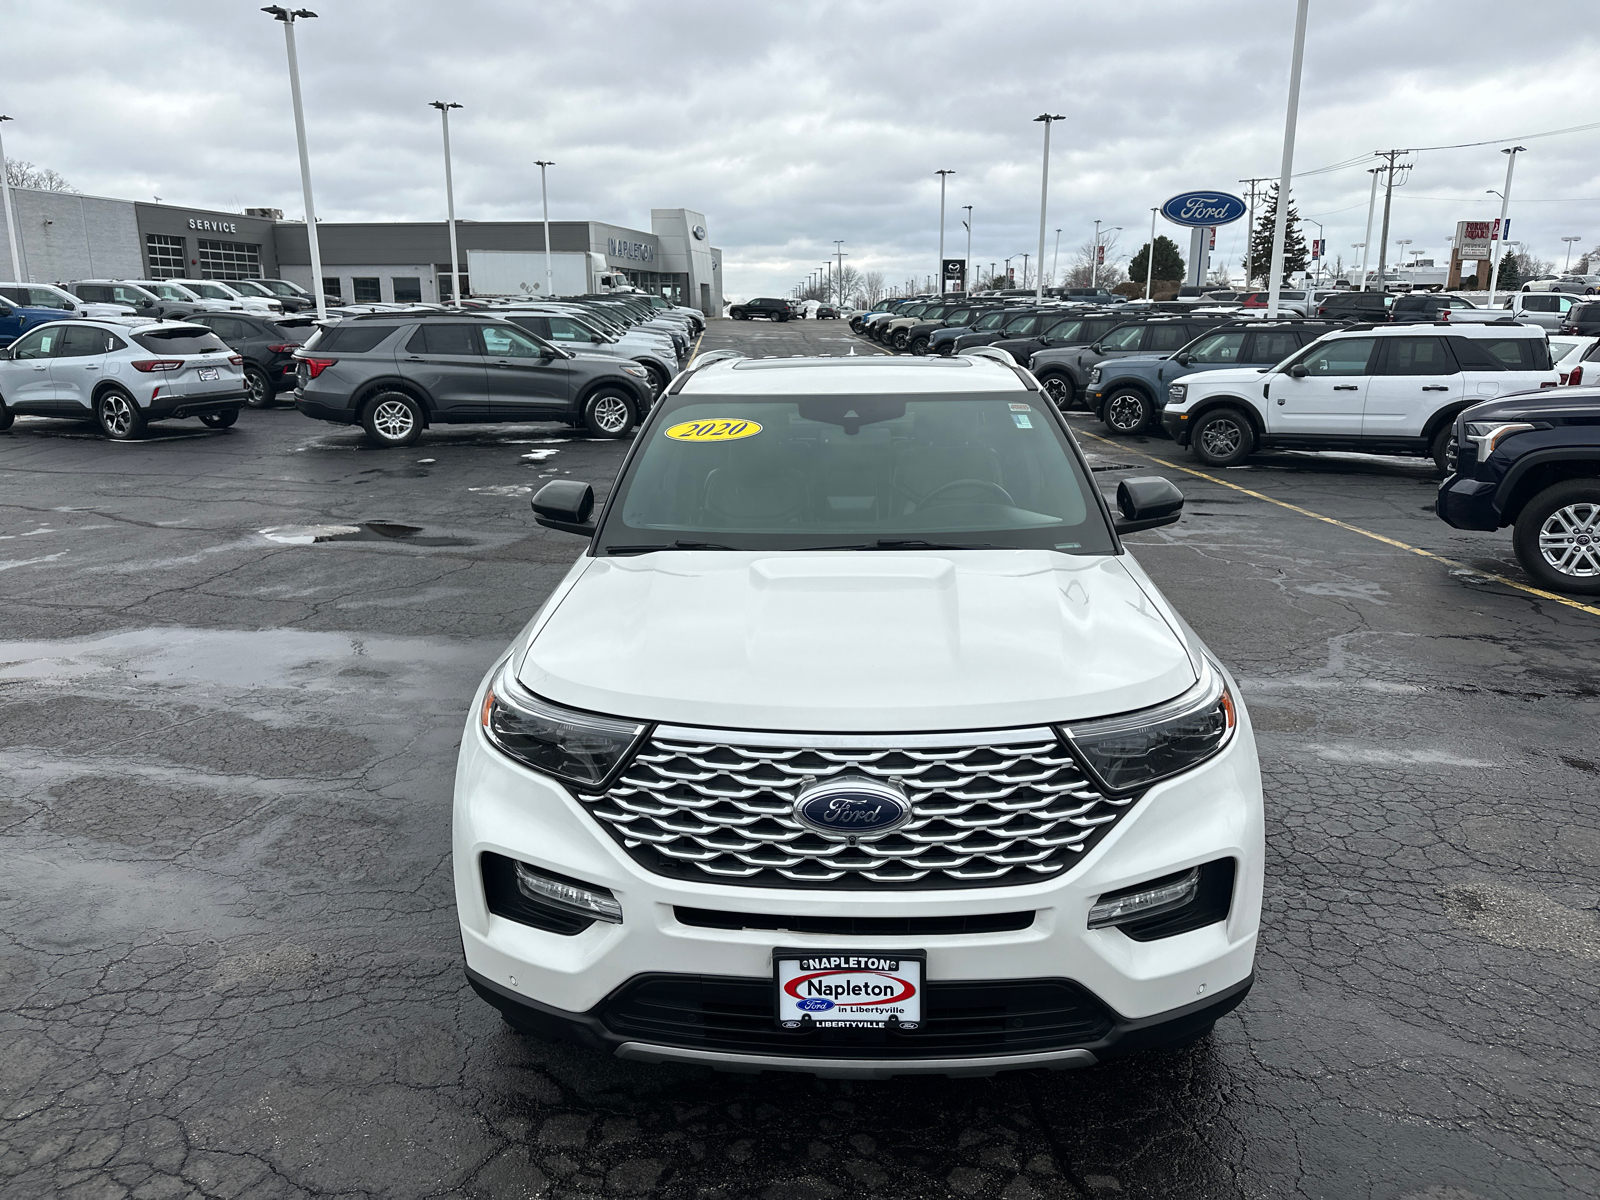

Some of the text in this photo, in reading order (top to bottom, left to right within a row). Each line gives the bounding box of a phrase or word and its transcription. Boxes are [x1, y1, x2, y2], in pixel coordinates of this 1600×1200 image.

[1180, 197, 1231, 219] Ford
[189, 218, 236, 233] SERVICE
[1466, 222, 1490, 231] FORUM
[1464, 230, 1489, 240] SQUARE
[608, 237, 654, 262] NAPLETON
[678, 422, 748, 437] 2020
[823, 798, 882, 823] Ford
[808, 957, 890, 971] NAPLETON
[807, 980, 894, 1000] Napleton
[804, 1000, 829, 1010] Ford
[838, 1006, 905, 1015] in Libertyville
[816, 1021, 885, 1029] LIBERTYVILLE
